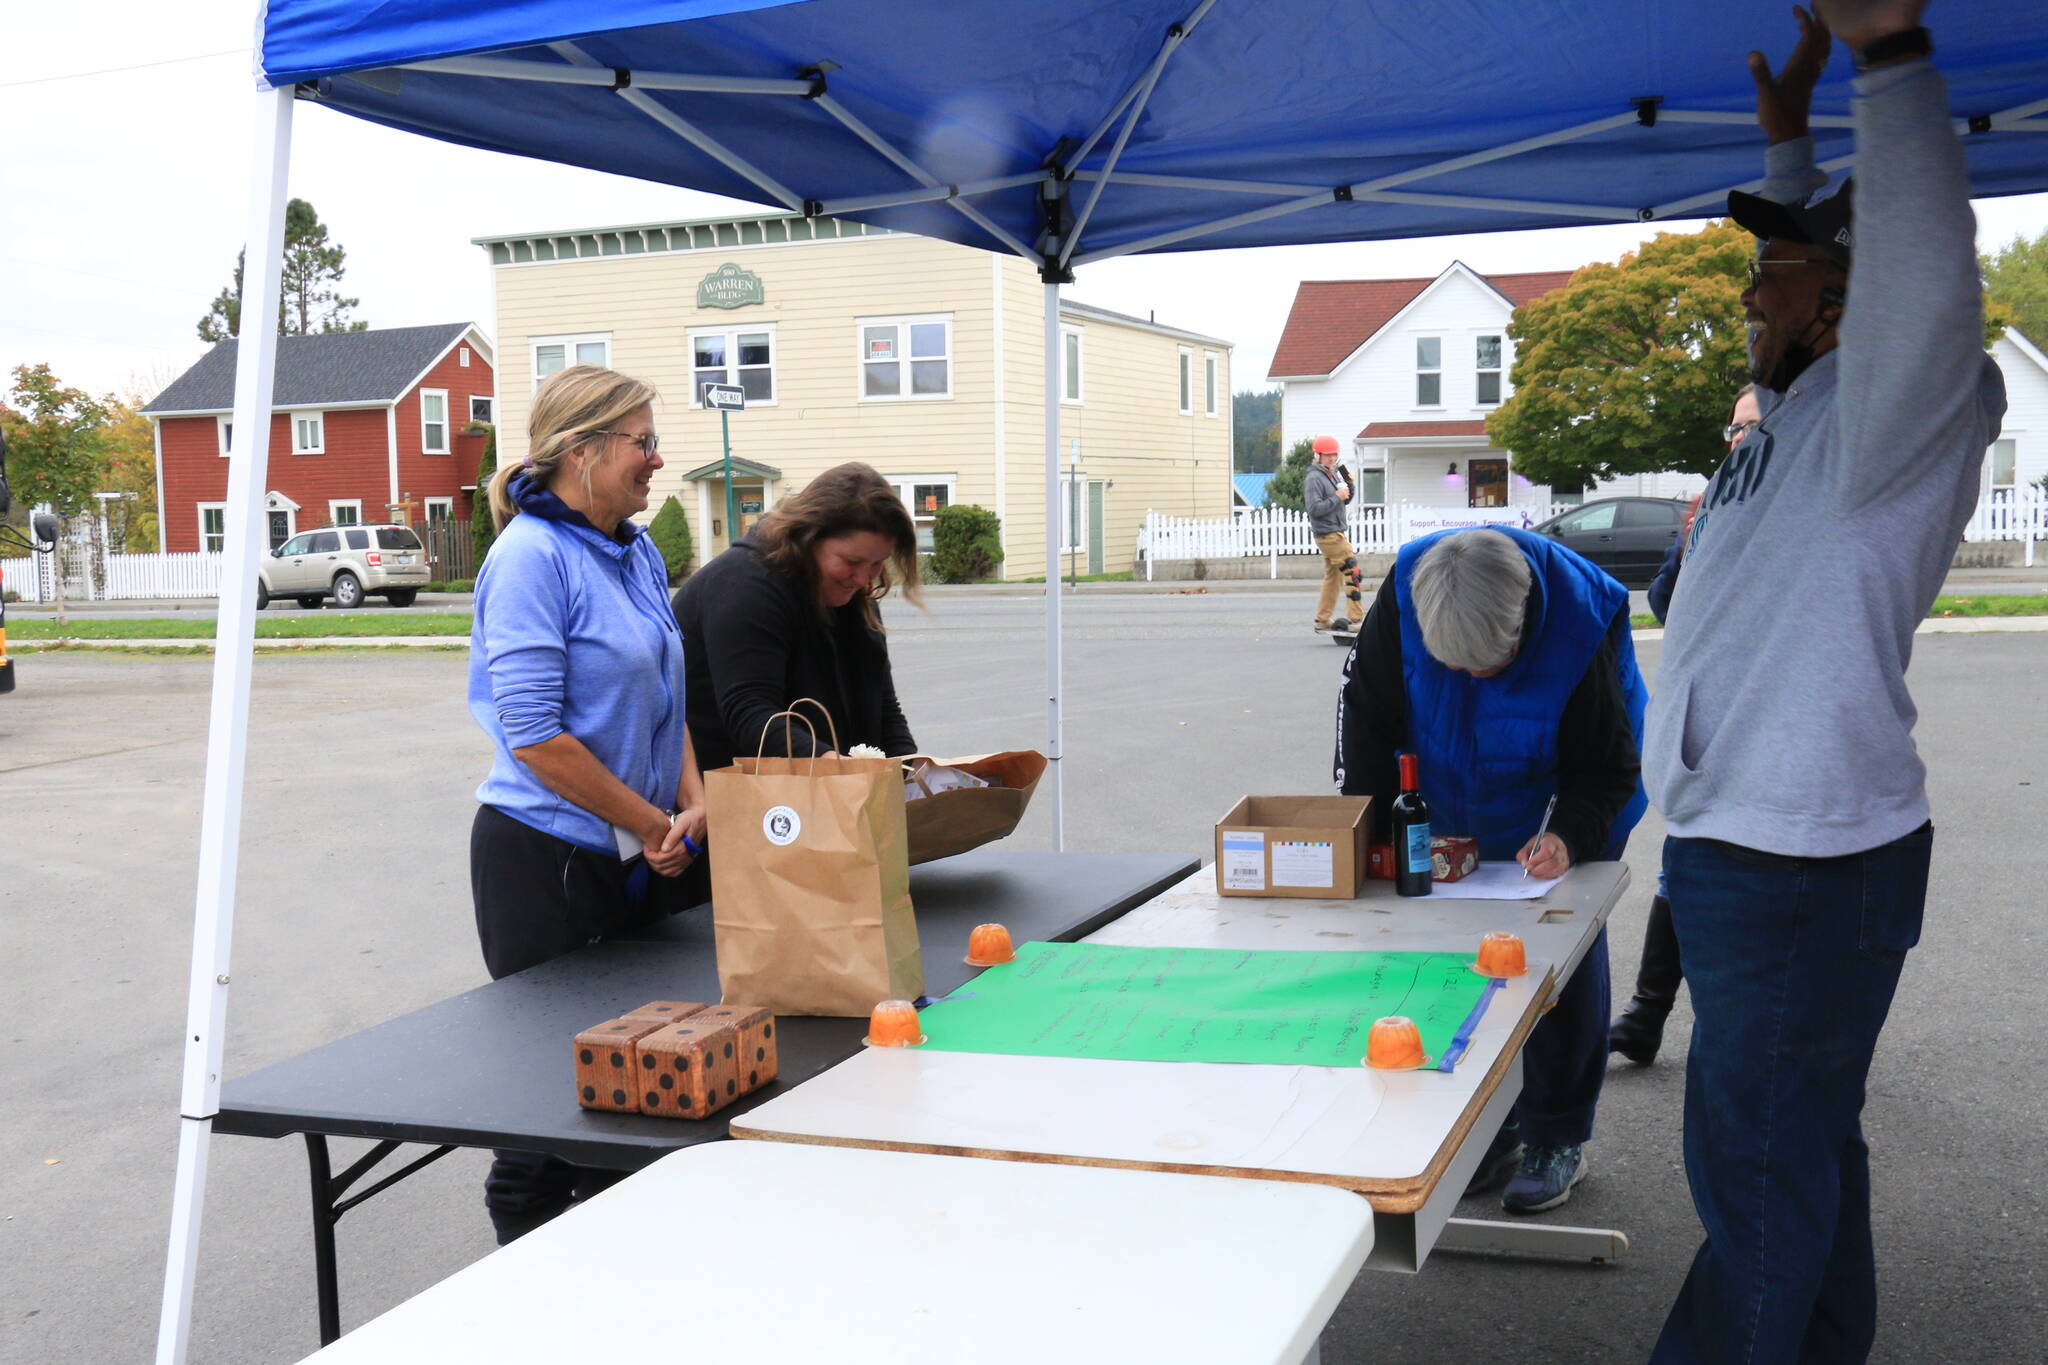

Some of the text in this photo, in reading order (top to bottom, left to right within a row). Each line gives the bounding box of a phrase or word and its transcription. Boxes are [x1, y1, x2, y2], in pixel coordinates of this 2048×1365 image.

[704, 279, 753, 294] WARREN
[717, 290, 742, 300] BLDG
[717, 392, 740, 402] ONE WAY
